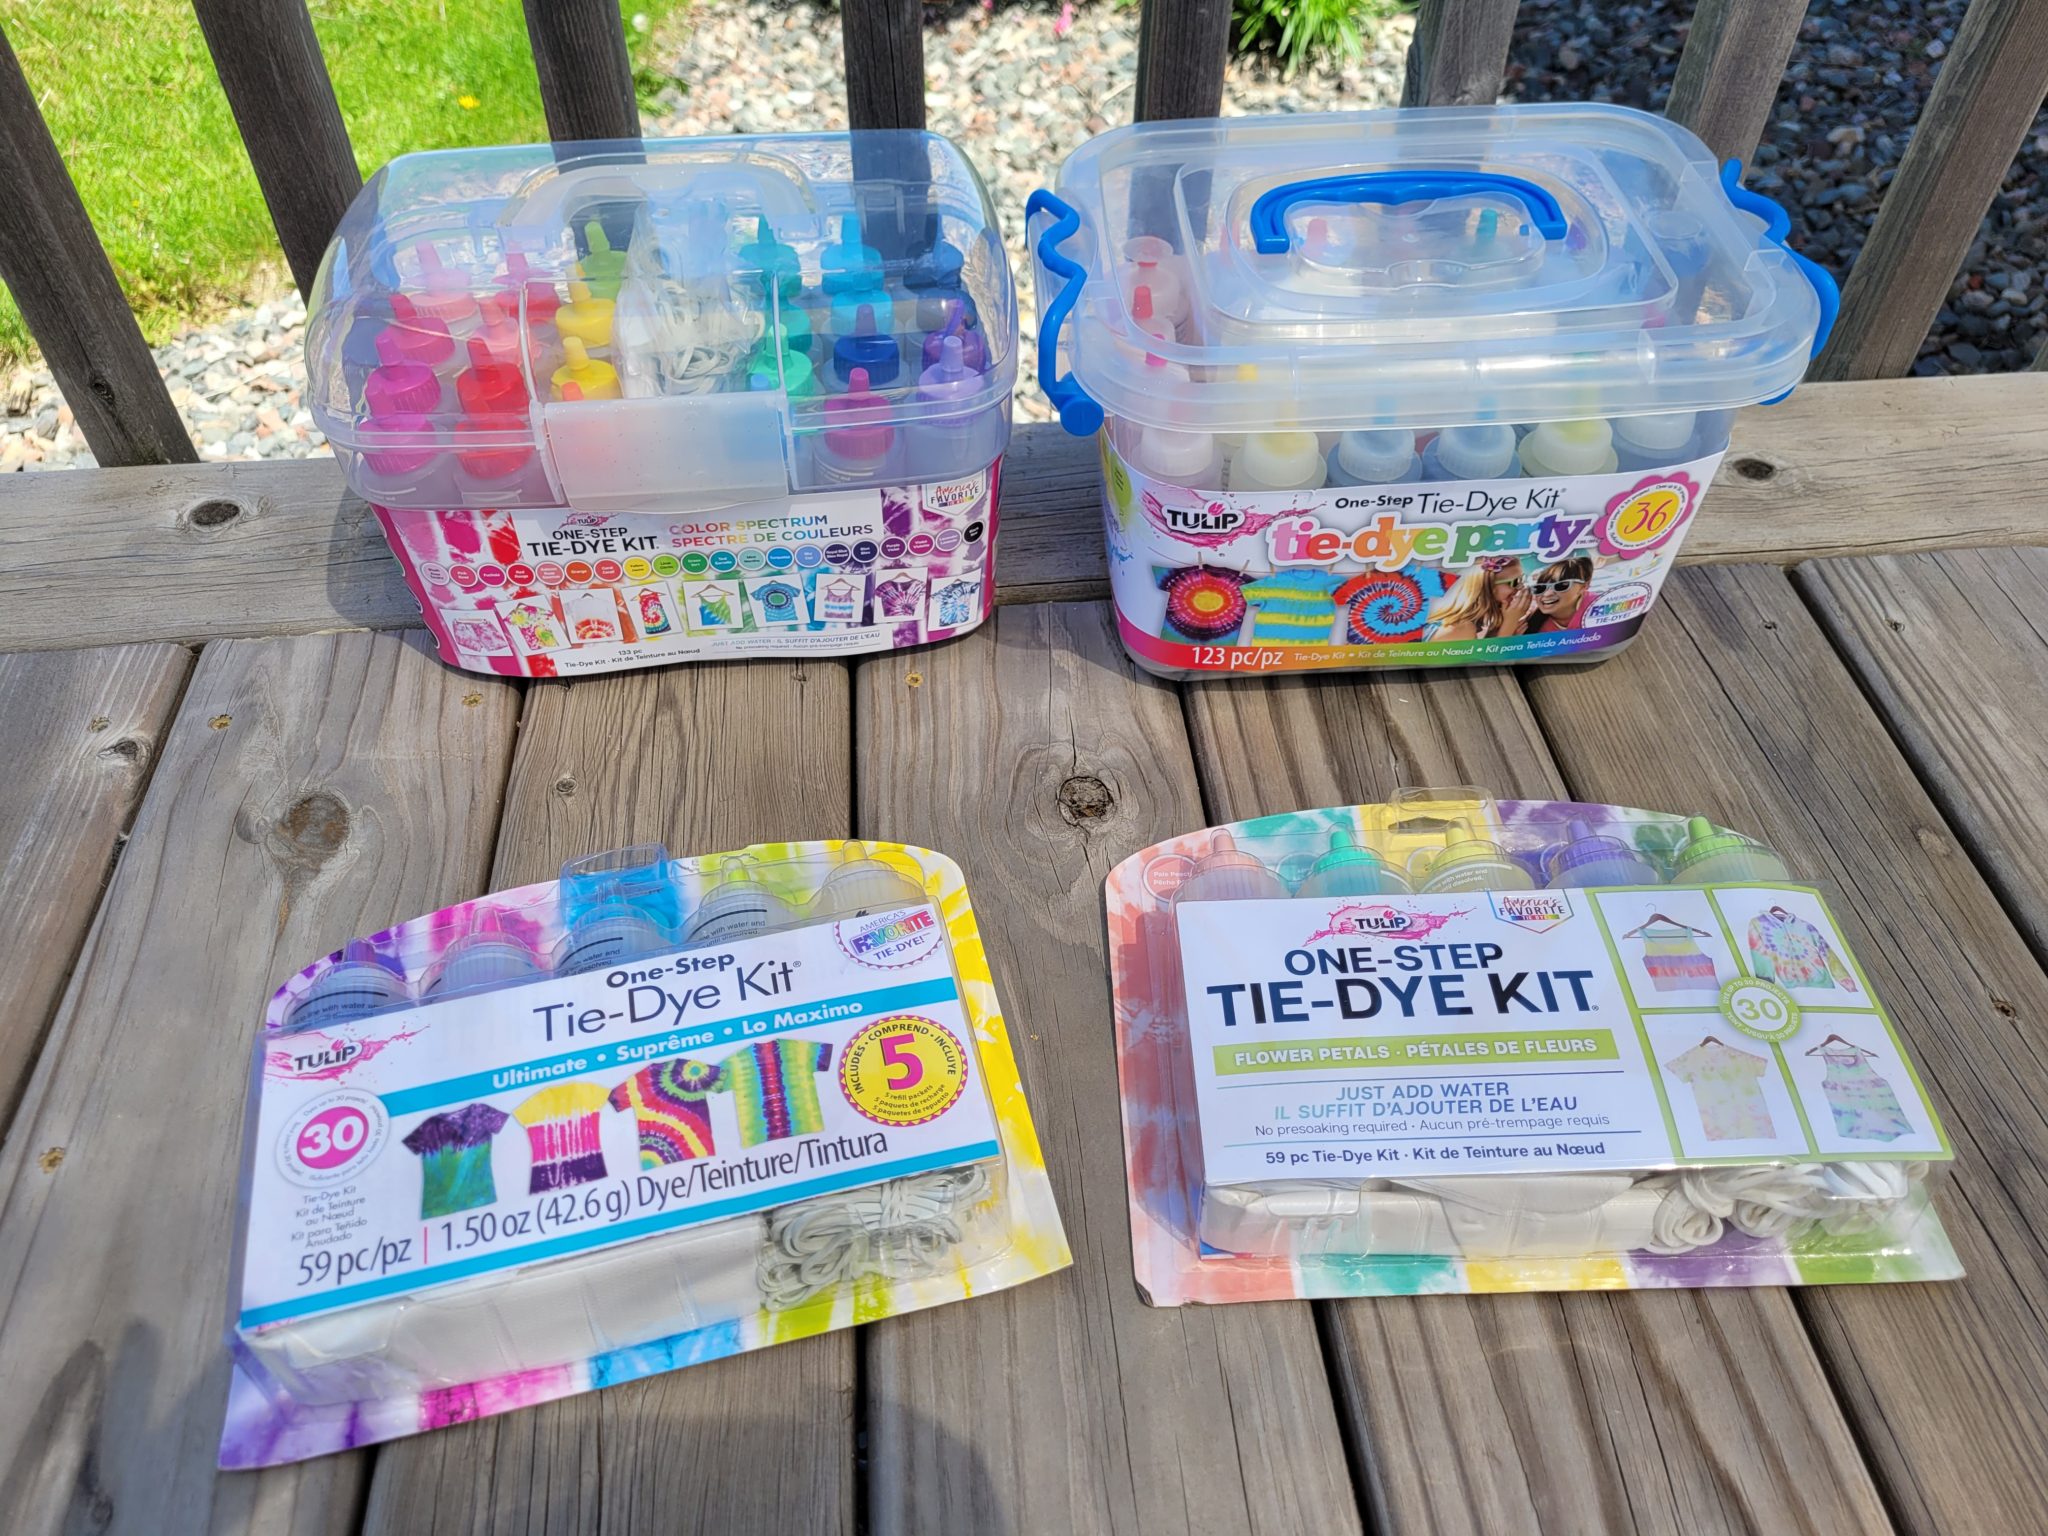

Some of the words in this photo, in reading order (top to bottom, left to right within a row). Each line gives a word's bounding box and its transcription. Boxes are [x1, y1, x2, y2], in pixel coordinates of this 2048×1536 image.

[931, 486, 979, 504] FAVORITE
[1335, 494, 1413, 509] One-Step
[1417, 491, 1517, 517] Tie-Dye
[1526, 488, 1560, 509] Kit
[669, 522, 730, 535] COLOR
[735, 515, 828, 531] SPECTRUM
[1167, 506, 1239, 530] TULIP
[1624, 499, 1673, 535] 36
[552, 527, 628, 541] ONE-STEP
[672, 533, 749, 548] SPECTRE
[754, 532, 776, 543] DE
[782, 524, 873, 541] COULEURS
[1271, 515, 1449, 567] tie-dye
[1450, 513, 1592, 563] party
[527, 538, 615, 557] TIE-DYE
[623, 536, 658, 552] KIT
[1589, 594, 1647, 617] FAVORITE
[861, 632, 880, 640] L'EAU
[1294, 652, 1329, 662] Tie-Dye
[1332, 652, 1345, 660] Kit
[1373, 650, 1386, 658] de
[1388, 648, 1424, 658] Teinture
[1426, 649, 1439, 657] au
[1442, 646, 1473, 656] Nœud
[1485, 644, 1499, 653] Kit
[1499, 643, 1523, 654] para
[1527, 638, 1555, 650] Teñido
[1557, 633, 1601, 646] Anudado
[635, 652, 665, 660] Teinture
[1191, 646, 1225, 665] 123
[1230, 647, 1284, 669] pc/pz
[1455, 869, 1474, 879] water
[1498, 905, 1566, 916] FAVORITE
[1503, 896, 1561, 911] America's
[727, 920, 749, 930] water
[852, 910, 935, 954] FAVORITE
[860, 909, 906, 933] AMERICA'S
[1354, 914, 1406, 931] TULIP
[582, 952, 603, 963] water
[873, 935, 925, 960] TIE-DYE!
[1284, 942, 1503, 976] ONE-STEP
[606, 953, 735, 989] One-Step
[341, 1002, 365, 1010] water
[532, 984, 721, 1042] Tie-Dye
[736, 960, 794, 1001] Kit
[1206, 973, 1474, 1027] TIE-DYE
[1487, 970, 1594, 1014] KIT
[1736, 998, 1783, 1021] 30
[491, 1056, 588, 1090] Ultimate
[616, 1030, 715, 1062] Suprême
[742, 1018, 767, 1035] Lo
[773, 999, 864, 1030] Maximo
[1234, 1046, 1313, 1067] FLOWER
[1320, 1044, 1391, 1062] PETALS
[1406, 1039, 1495, 1059] PÉTALES
[1498, 1040, 1520, 1055] DE
[1524, 1037, 1598, 1055] FLEURS
[294, 1043, 357, 1071] TULIP
[850, 1044, 866, 1095] INCLUDES
[868, 1023, 929, 1041] COMPREND
[934, 1035, 957, 1076] INCLUYE
[879, 1032, 924, 1091] 5
[880, 1099, 908, 1109] paquets
[920, 1083, 945, 1105] recharge
[908, 1084, 934, 1101] packets
[1336, 1085, 1385, 1101] JUST
[1392, 1084, 1434, 1099] ADD
[1440, 1081, 1510, 1098] WATER
[878, 1105, 911, 1116] paquetes
[922, 1091, 949, 1112] repuesto
[1274, 1105, 1291, 1120] IL
[1298, 1102, 1365, 1119] SUFFIT
[1372, 1099, 1482, 1117] D'AJOUTER
[1489, 1098, 1515, 1113] DE
[1521, 1096, 1578, 1112] L'EAU
[300, 1115, 364, 1159] 30
[1255, 1125, 1273, 1136] No
[1277, 1121, 1350, 1137] presoaking
[1352, 1120, 1407, 1135] required
[1419, 1118, 1463, 1131] Aucun
[1467, 1115, 1563, 1132] pré-trempage
[1567, 1113, 1610, 1127] requis
[1266, 1151, 1285, 1164] 59
[1290, 1152, 1309, 1166] pc
[1312, 1149, 1373, 1165] Tie-Dye
[1376, 1148, 1400, 1161] Kit
[1412, 1146, 1436, 1160] Kit
[1440, 1145, 1459, 1159] de
[1463, 1144, 1529, 1158] Teinture
[1533, 1145, 1552, 1156] au
[1556, 1141, 1606, 1156] Nœud
[303, 1190, 340, 1204] Tie-Dye
[343, 1185, 356, 1195] Kit
[296, 1207, 309, 1218] Kit
[312, 1204, 325, 1215] de
[328, 1196, 366, 1211] Teinture
[297, 1250, 332, 1286] 59
[337, 1235, 413, 1286] pc/pz
[440, 1211, 498, 1252] 1.50
[502, 1207, 531, 1234] oz
[536, 1189, 602, 1236] (42.6
[605, 1179, 632, 1220] g)
[637, 1128, 889, 1208] Dye/Teinture/Tintura
[305, 1218, 319, 1226] au
[321, 1207, 355, 1222] Nœud
[291, 1231, 304, 1242] Kit
[307, 1227, 332, 1239] para
[335, 1217, 368, 1231] Teñido
[305, 1231, 352, 1249] Anudado
